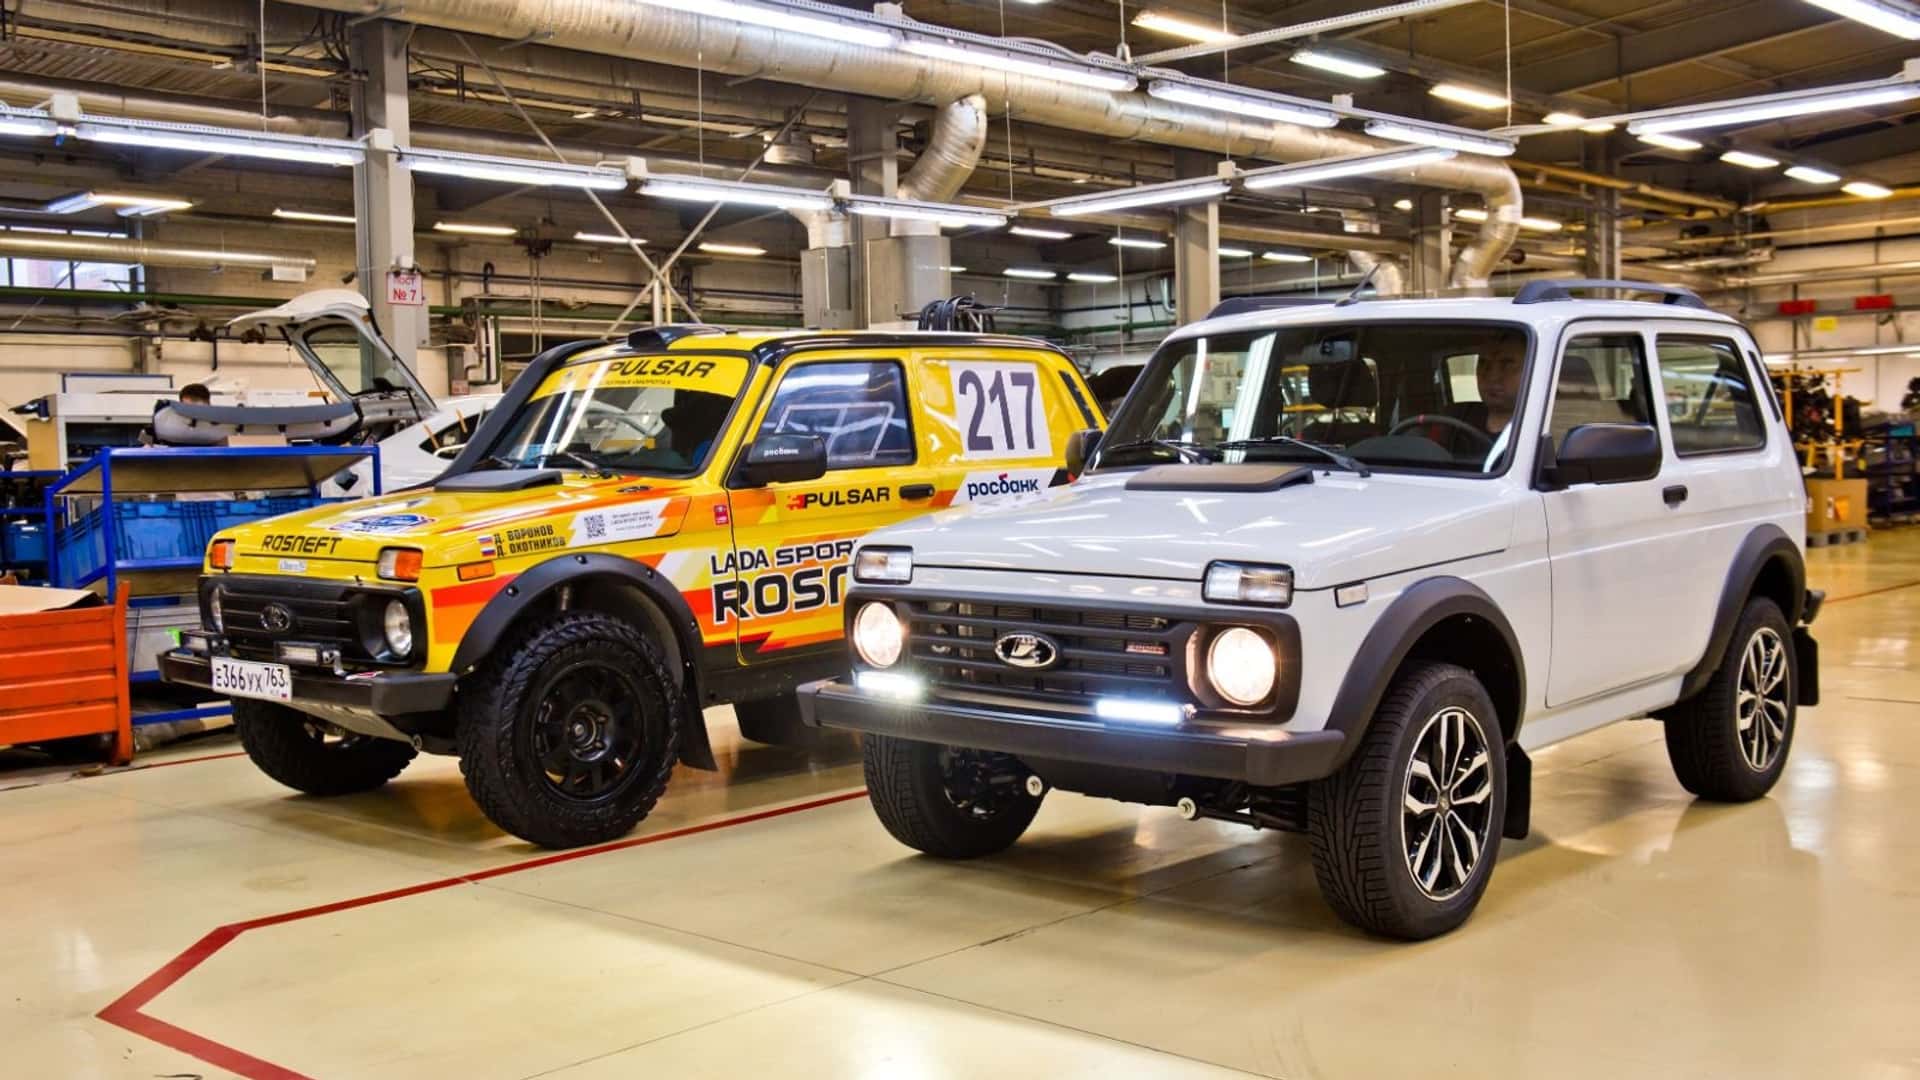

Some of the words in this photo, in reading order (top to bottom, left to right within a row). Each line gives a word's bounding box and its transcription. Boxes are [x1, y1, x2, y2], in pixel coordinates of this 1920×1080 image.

[410, 289, 417, 301] 7
[608, 359, 716, 378] PULSAR
[958, 369, 1036, 451] 217
[967, 473, 1039, 501] росбанк
[803, 486, 890, 509] PULSAR
[507, 524, 554, 541] ВОРОНОВ
[262, 535, 343, 555] ROSNEFT
[509, 536, 566, 554] ОХОТНИКОВ
[711, 548, 770, 575] LADA
[775, 539, 857, 567] SPOR
[264, 667, 286, 688] 763
